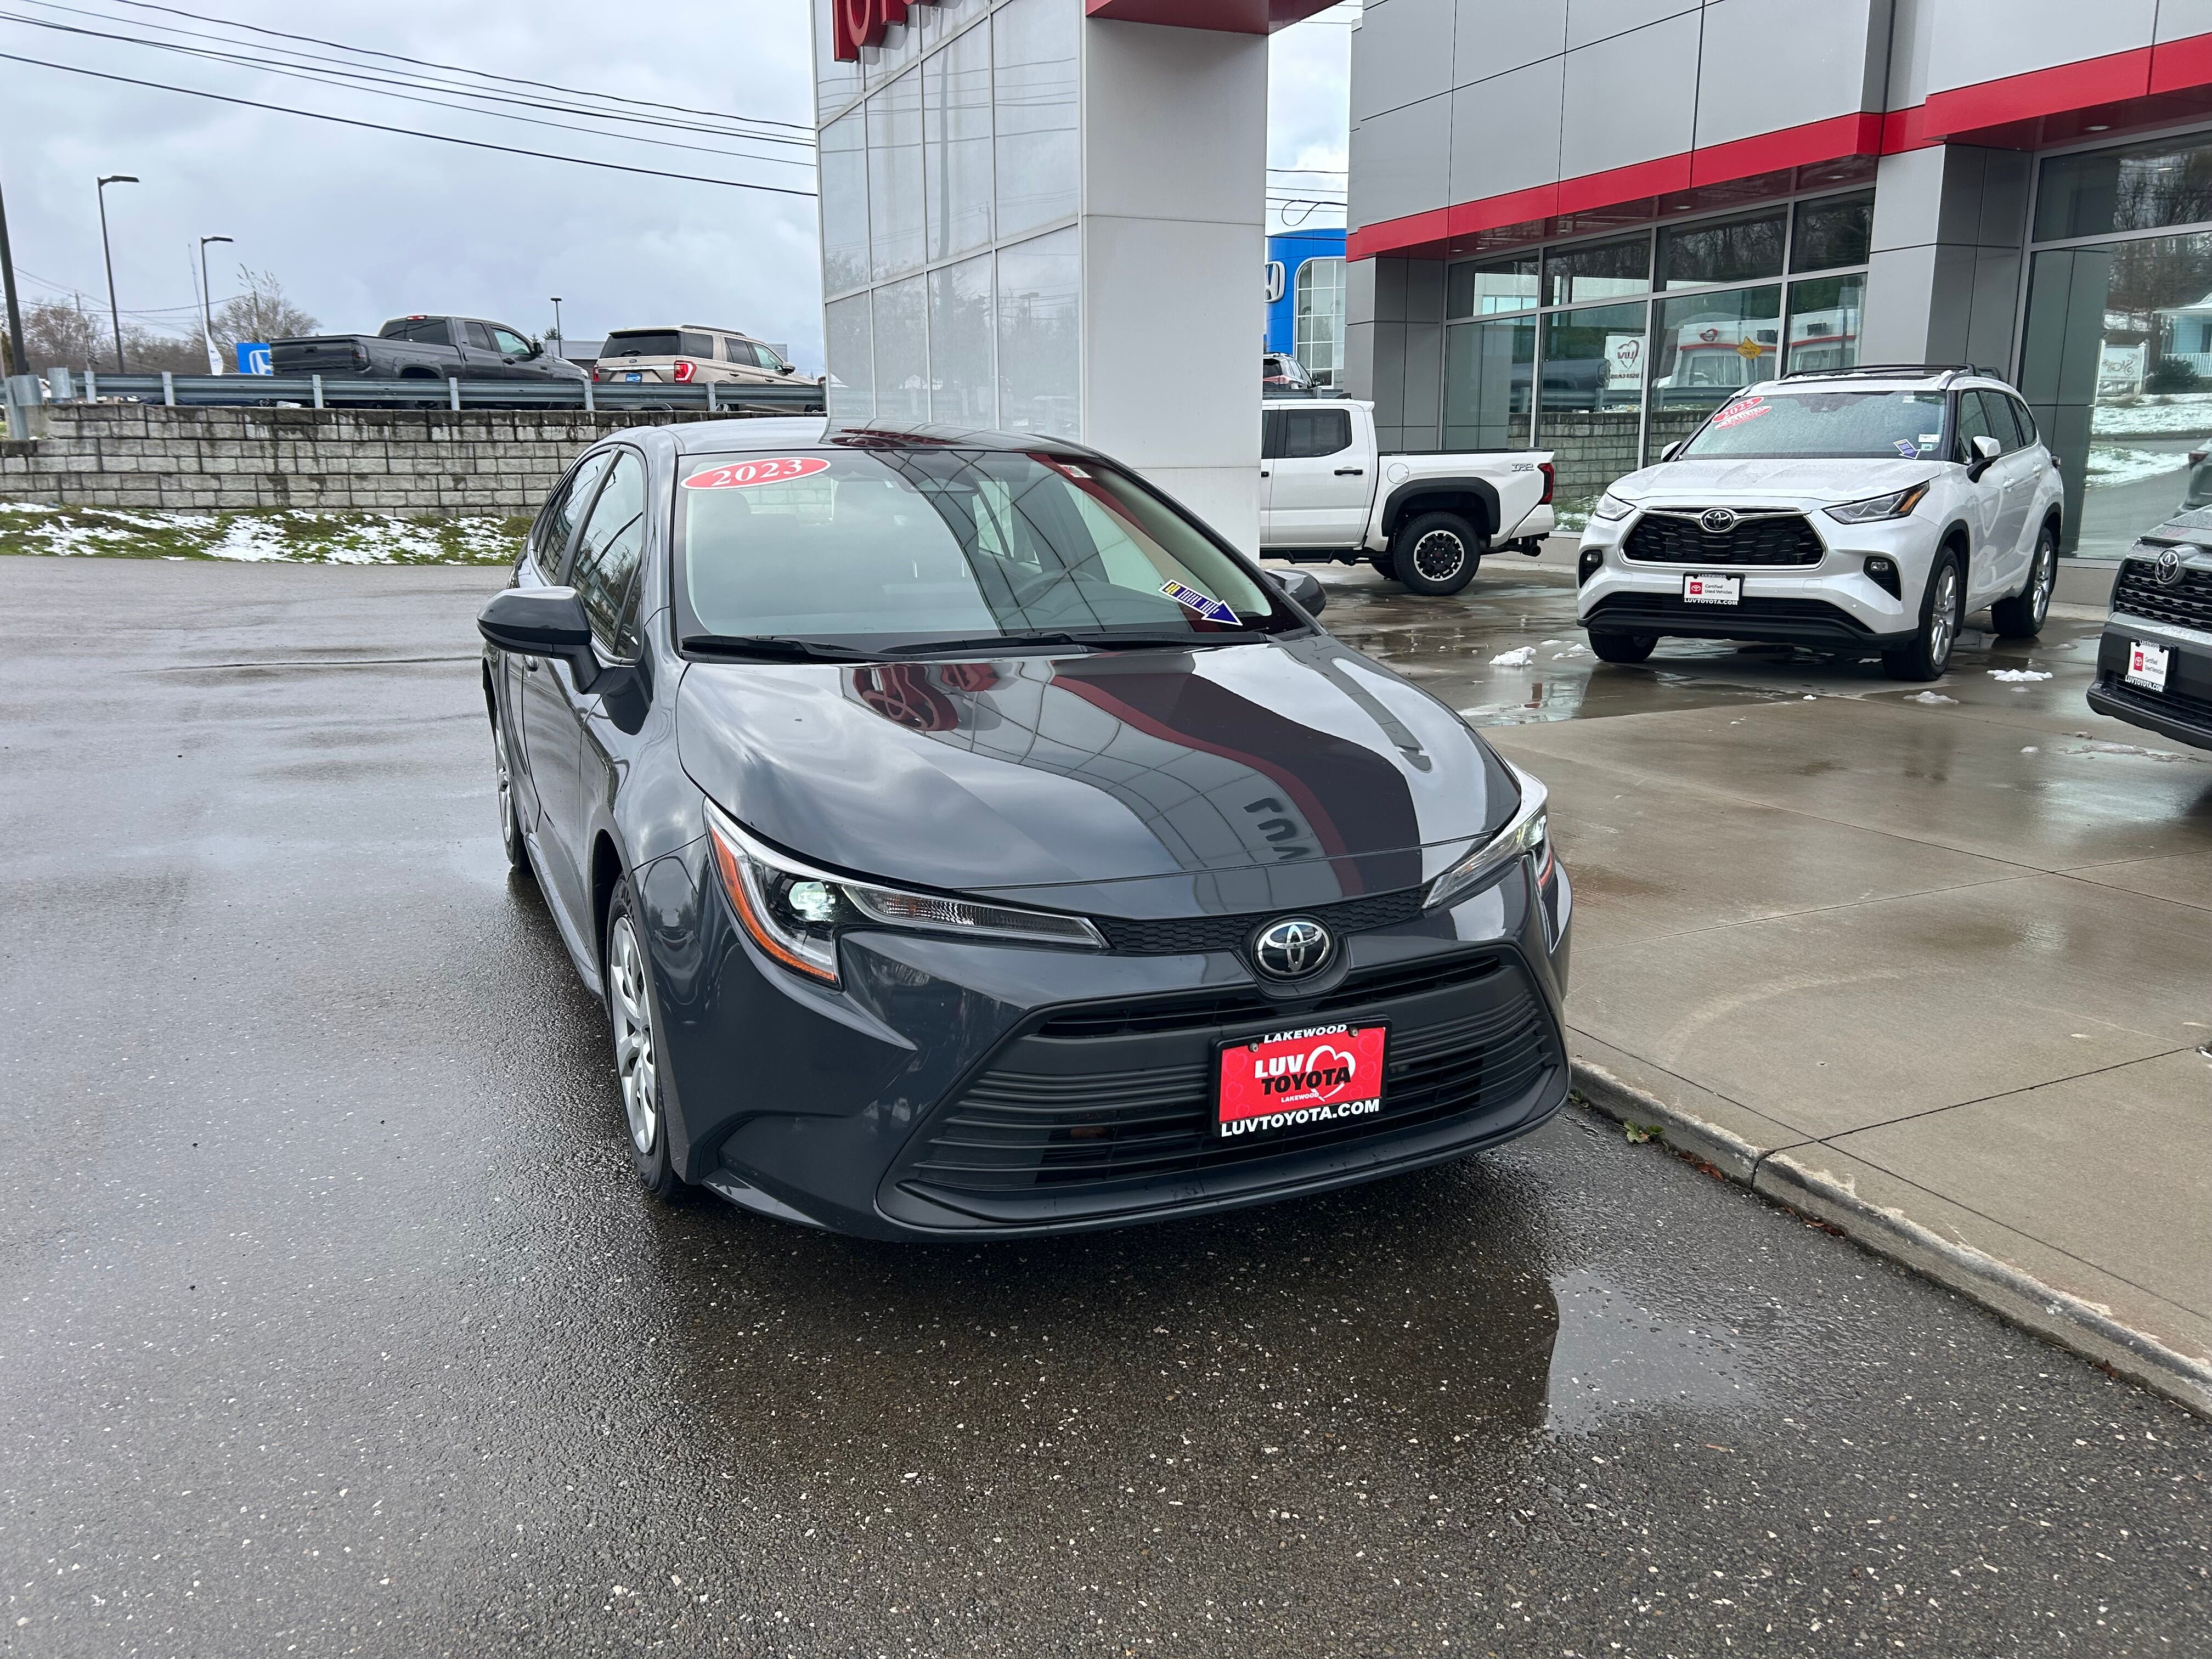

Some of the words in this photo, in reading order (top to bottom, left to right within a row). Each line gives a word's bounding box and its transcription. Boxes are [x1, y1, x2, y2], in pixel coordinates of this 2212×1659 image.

[1722, 400, 1754, 419] 2025
[710, 459, 803, 487] 2023
[2125, 675, 2163, 692] LUVTOYOTA.COM
[1263, 1024, 1347, 1043] LAKEWOOD
[1255, 1053, 1305, 1079] LUV
[1262, 1066, 1351, 1095] TOYOTA
[1281, 1092, 1320, 1103] LAKEWOOD
[1221, 1098, 1380, 1137] LUVTOYOTA.COM
